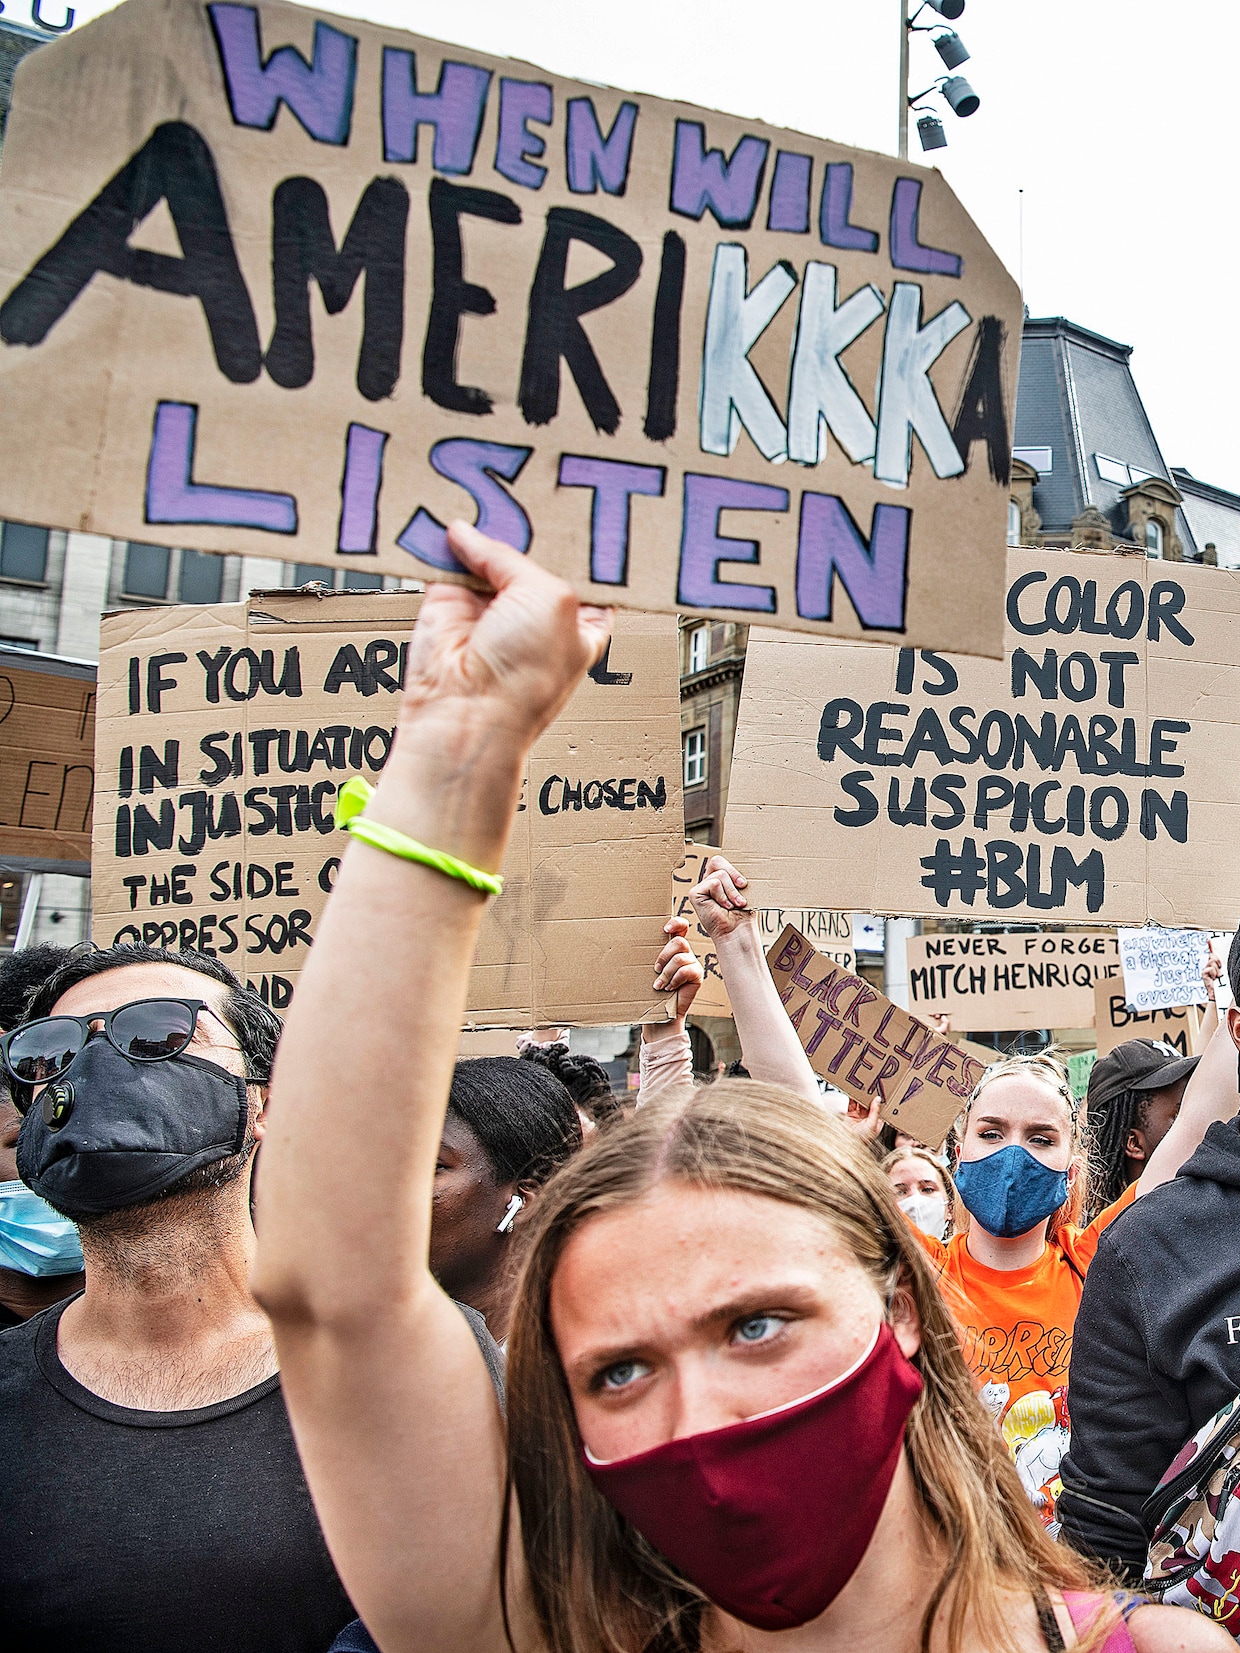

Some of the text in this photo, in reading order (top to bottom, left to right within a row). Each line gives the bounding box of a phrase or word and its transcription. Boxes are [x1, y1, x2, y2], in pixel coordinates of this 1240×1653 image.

[208, 3, 965, 278] WHEN WILL
[0, 120, 1010, 487] AMERIKKKA
[143, 400, 913, 634] LISTEN
[1007, 571, 1195, 646] COLOR
[129, 652, 187, 715] IF
[196, 645, 303, 703] YOU
[324, 639, 410, 697] AR
[895, 647, 1139, 708] IS NOT
[118, 739, 180, 798] IN
[817, 697, 1191, 778] REASONABLE
[115, 780, 349, 857] INJUSTIC
[539, 774, 667, 815] CHOSEN
[833, 771, 1188, 843] SUSPICION
[123, 863, 197, 910] THE
[209, 860, 300, 901] SIDE
[920, 838, 1105, 913] #BLM
[926, 938, 1007, 958] NEVER
[1123, 932, 1208, 952] anywhere
[1126, 948, 1200, 970] a threat
[774, 933, 877, 1028] BLACK
[874, 1005, 986, 1097] LIVES
[910, 963, 986, 1001] MITCH
